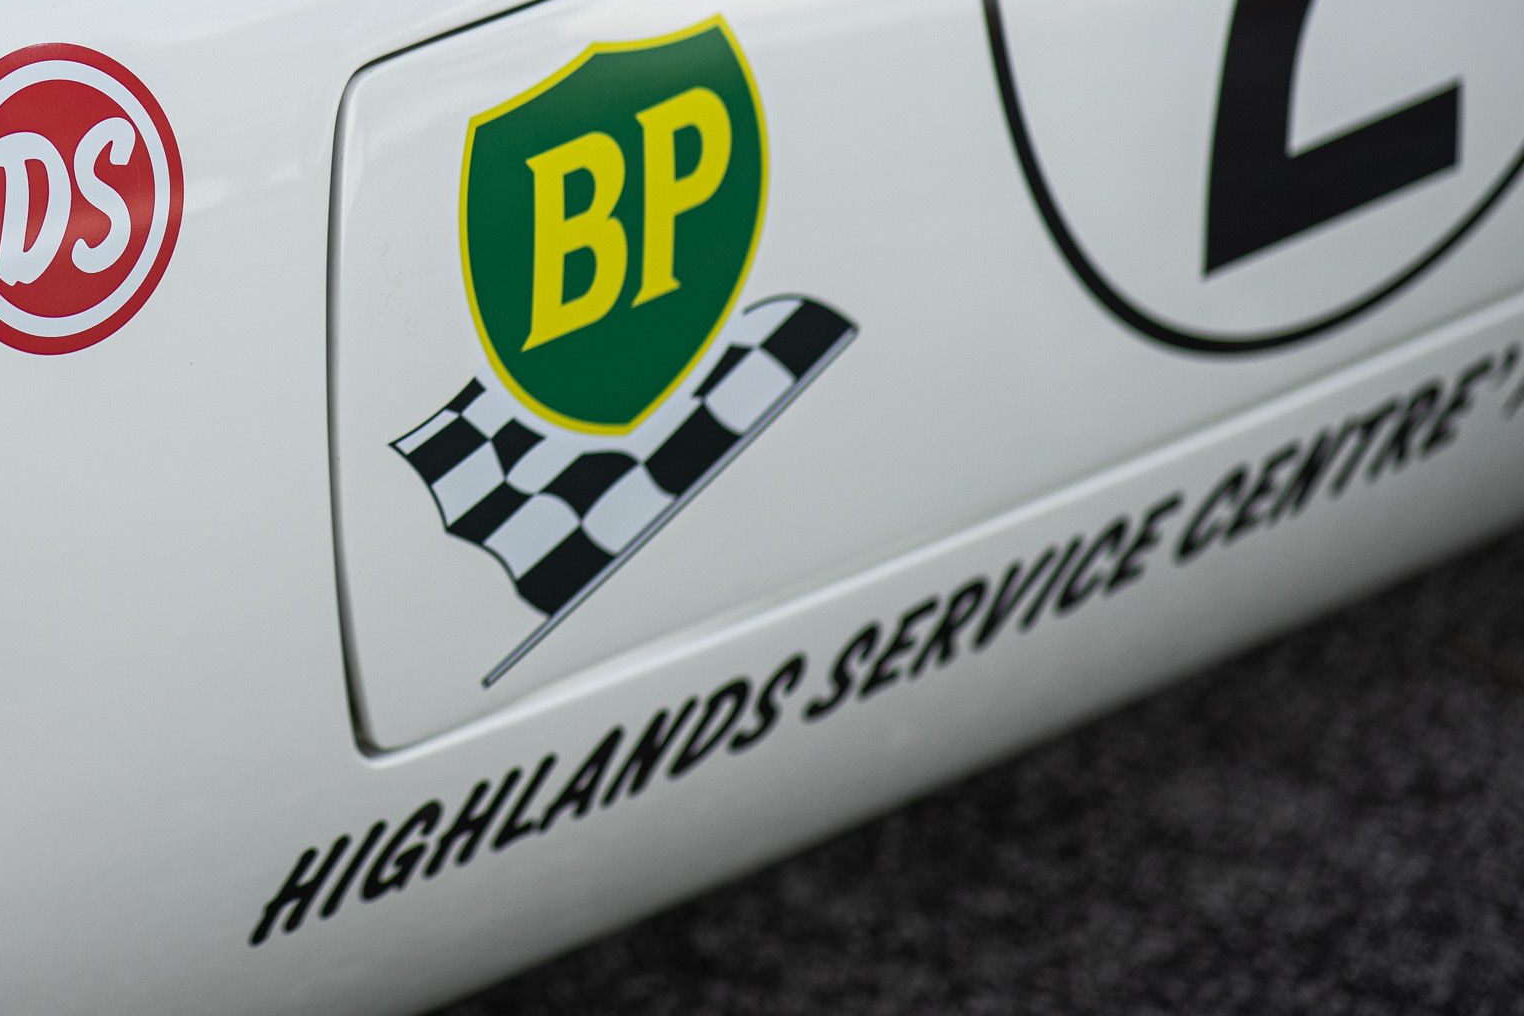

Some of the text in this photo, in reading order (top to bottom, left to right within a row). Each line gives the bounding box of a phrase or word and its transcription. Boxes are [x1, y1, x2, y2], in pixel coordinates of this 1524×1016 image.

[521, 86, 733, 353] BP
[247, 654, 808, 948] HIGHLANDS
[802, 494, 1184, 723] SERVICE
